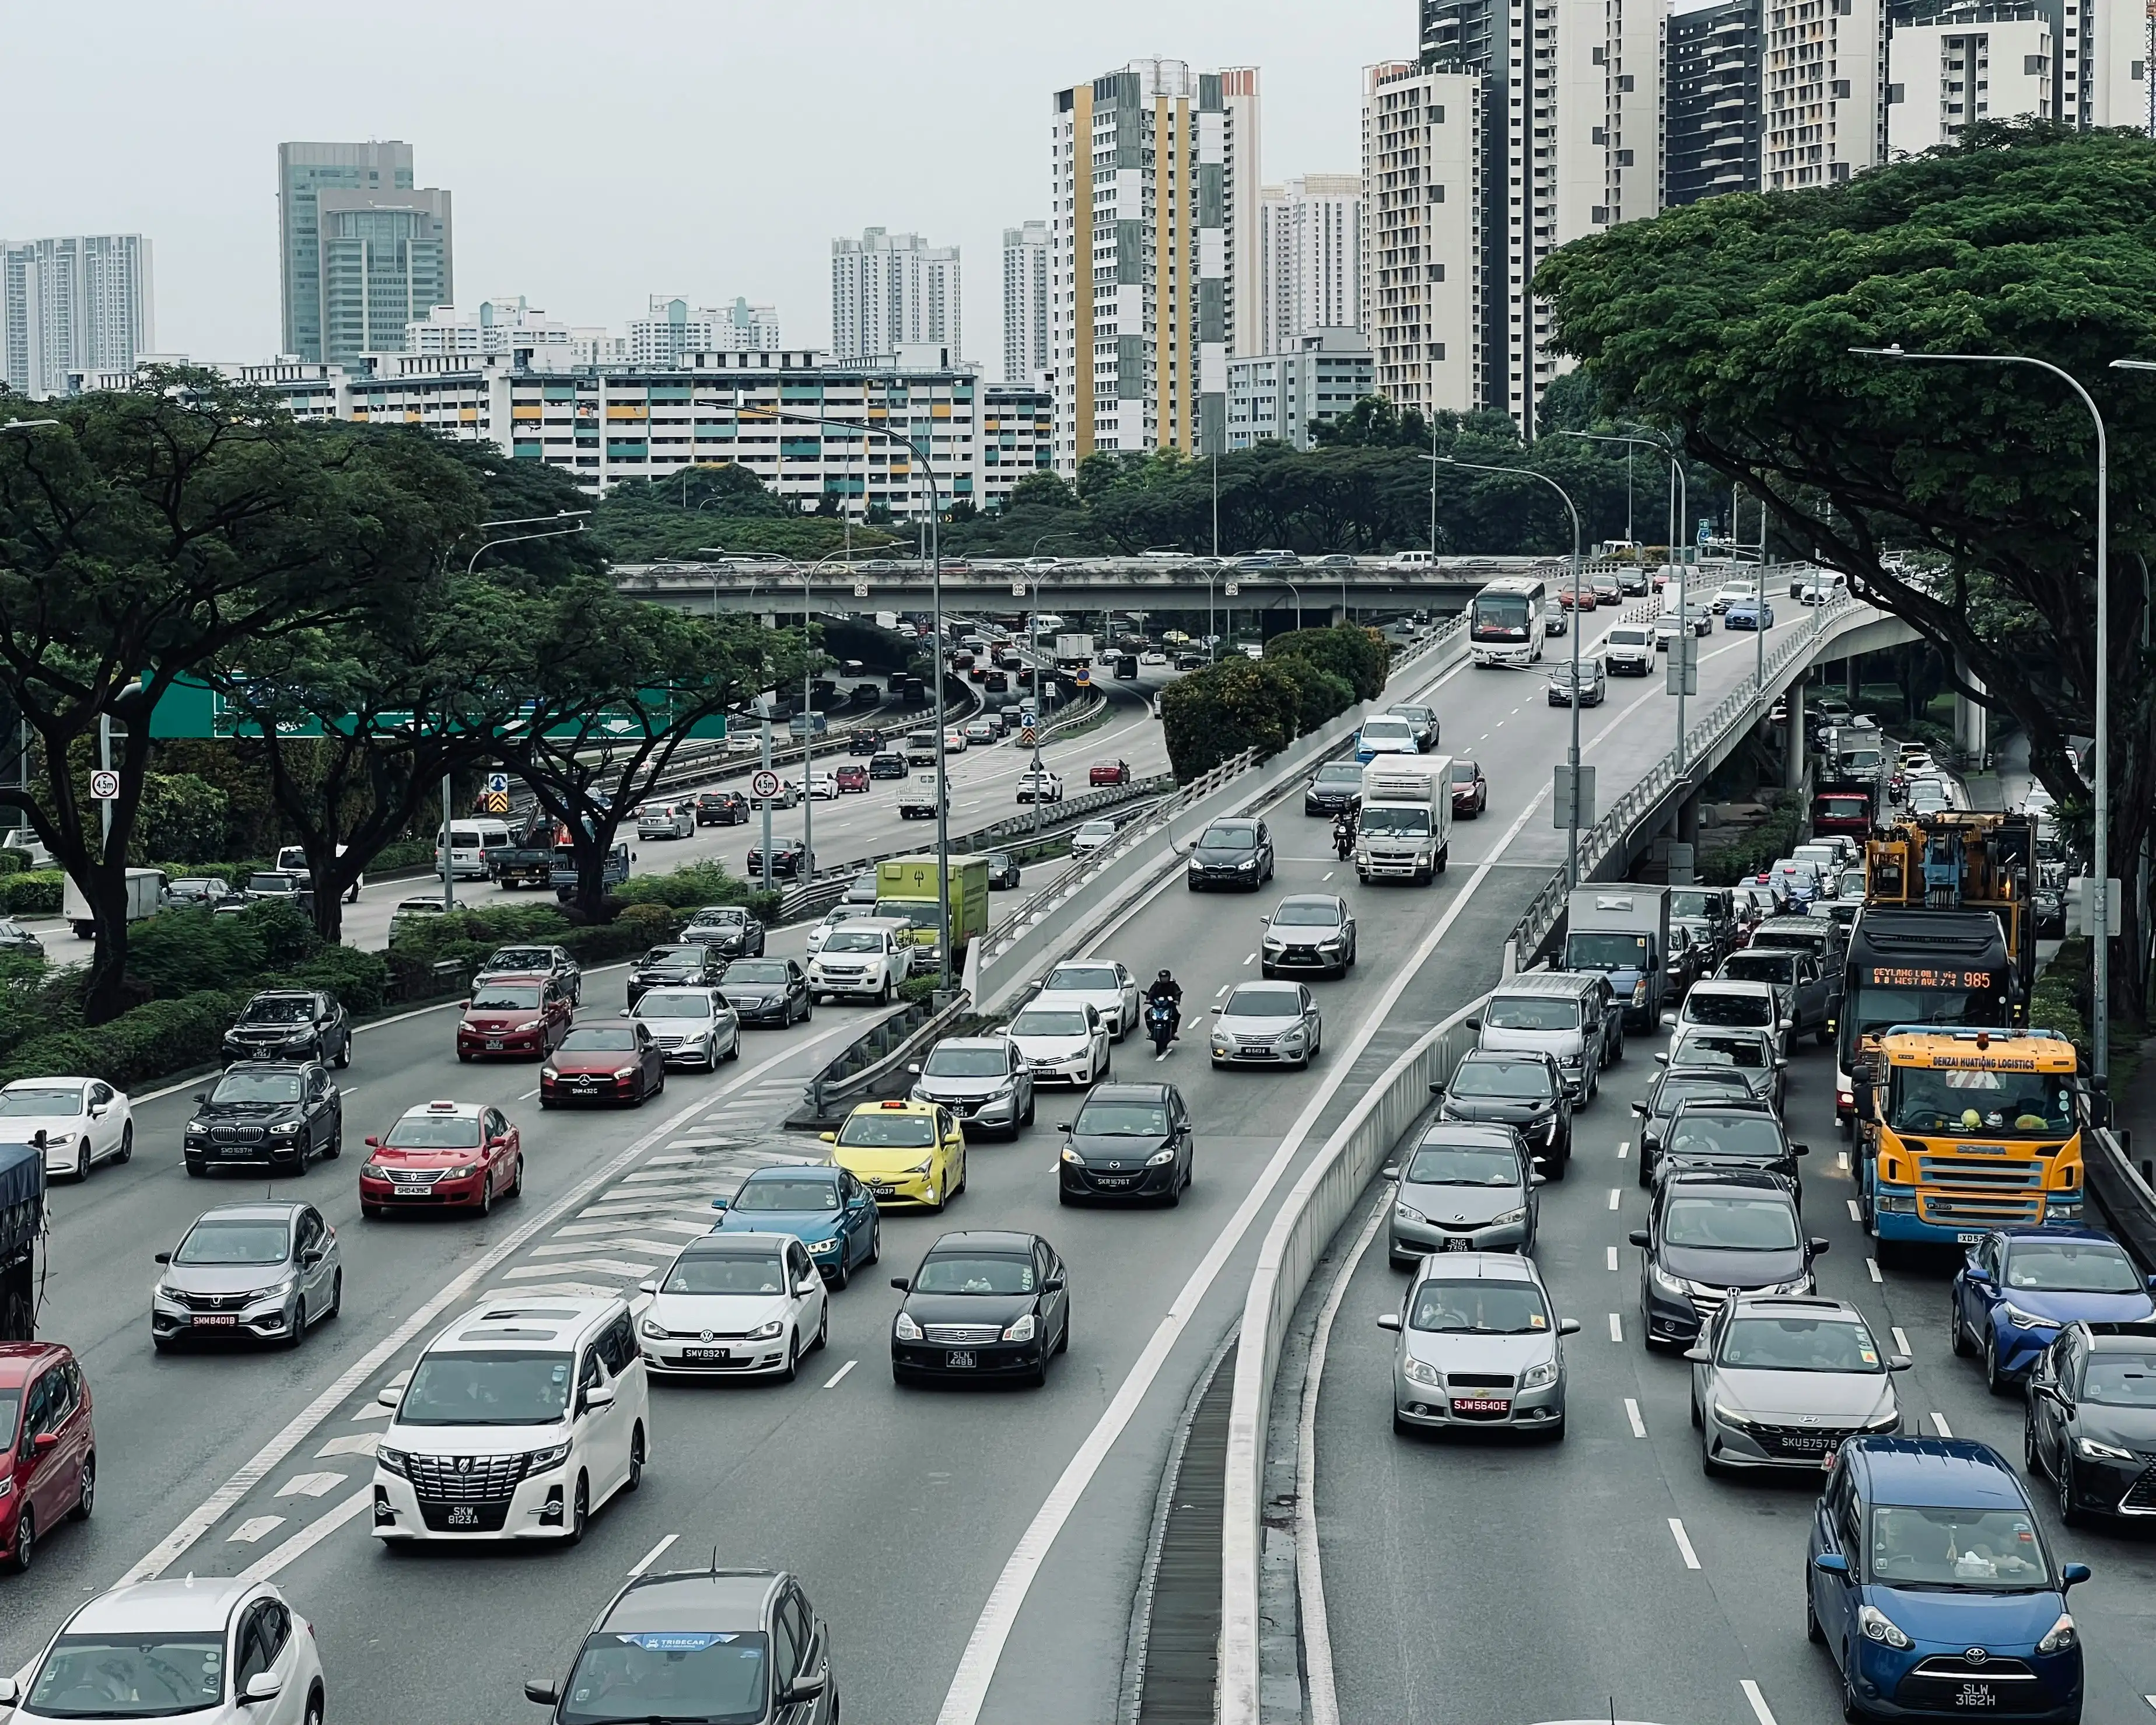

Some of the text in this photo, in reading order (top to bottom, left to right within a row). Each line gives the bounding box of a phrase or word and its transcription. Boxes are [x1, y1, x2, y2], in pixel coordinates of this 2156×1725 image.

[96, 781, 113, 790] 4.5m
[758, 779, 774, 789] 4.5m
[1964, 972, 1990, 988] 985
[1933, 1056, 2035, 1069] DENZAI HUATIONG LOGISTICS
[1454, 1400, 1507, 1411] SJW5640E
[1782, 1437, 1838, 1448] SKU5757B
[454, 1507, 473, 1515] SKW
[448, 1515, 478, 1524] 8123A
[1963, 1684, 1989, 1695] SLW
[1955, 1694, 1995, 1706] 3162H
